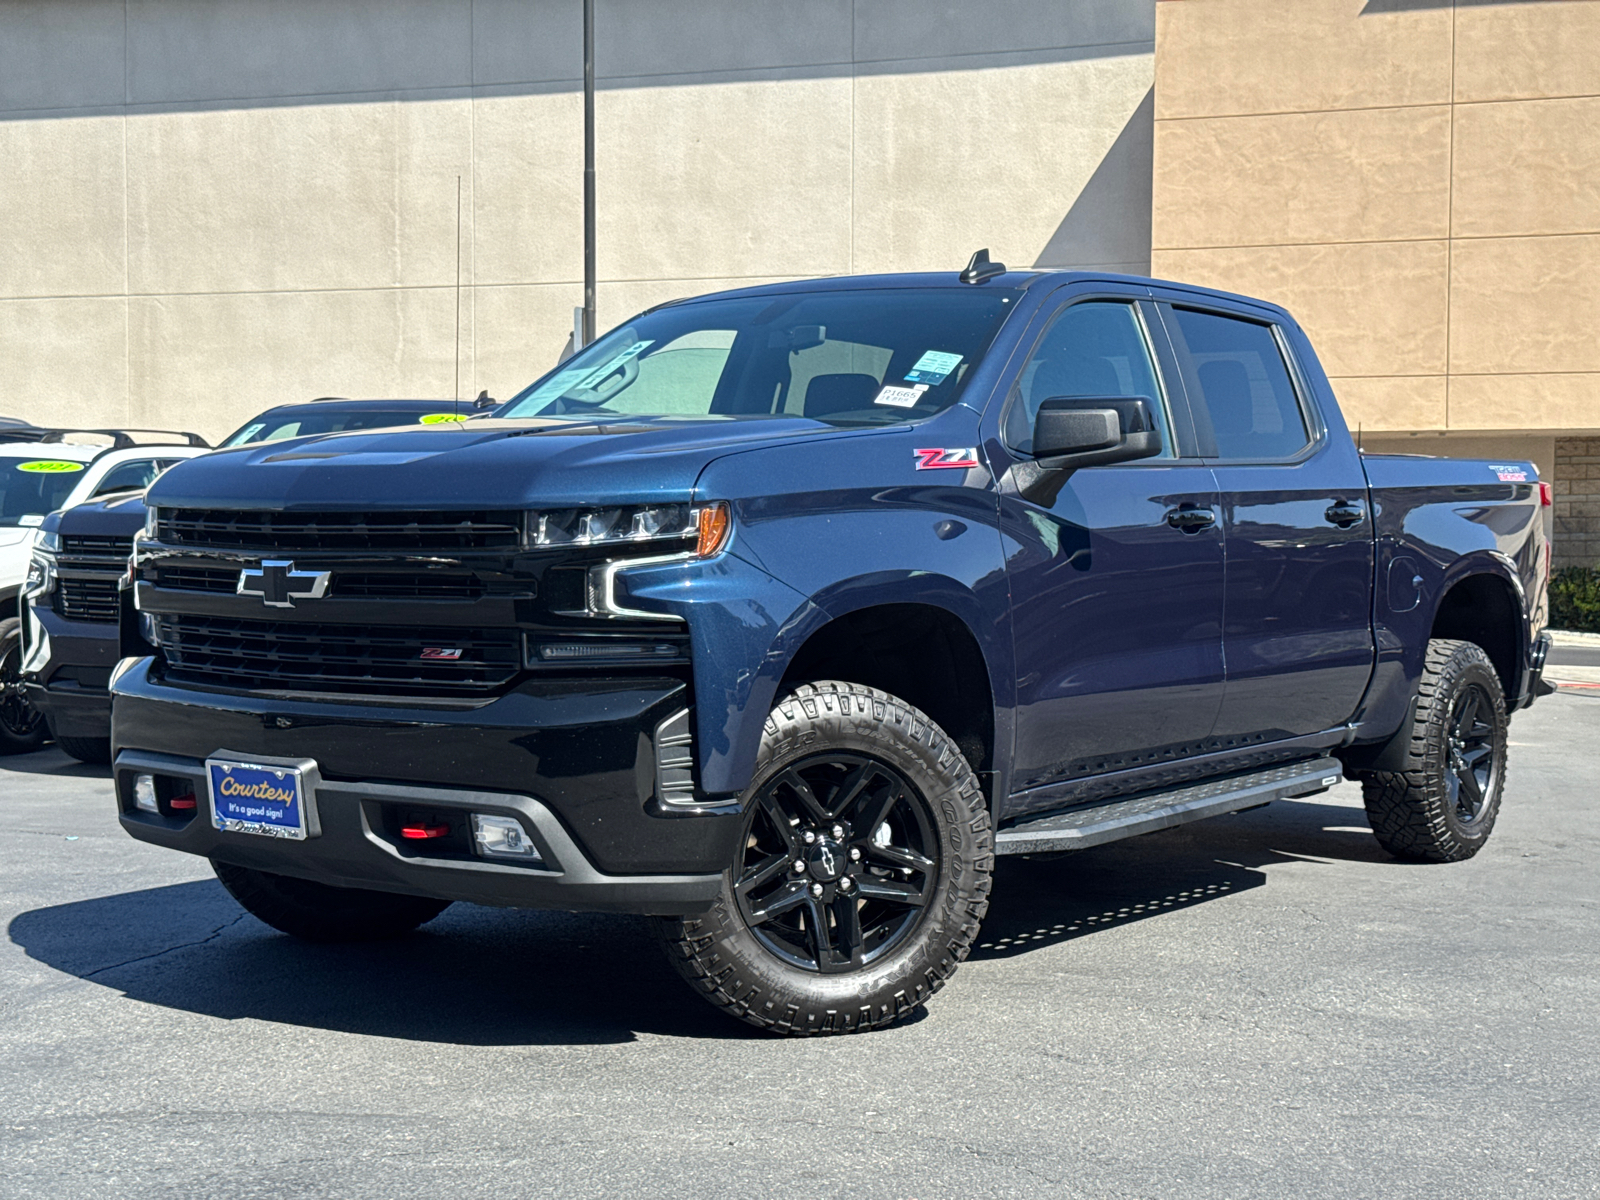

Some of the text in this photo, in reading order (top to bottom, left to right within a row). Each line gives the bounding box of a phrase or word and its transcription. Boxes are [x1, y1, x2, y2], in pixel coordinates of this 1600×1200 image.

[883, 389, 917, 399] P1665
[913, 448, 979, 471] Z71
[420, 648, 463, 659] Z71
[221, 777, 294, 807] Courtesy
[229, 803, 240, 813] It's
[247, 806, 265, 817] good
[266, 807, 283, 820] sign!
